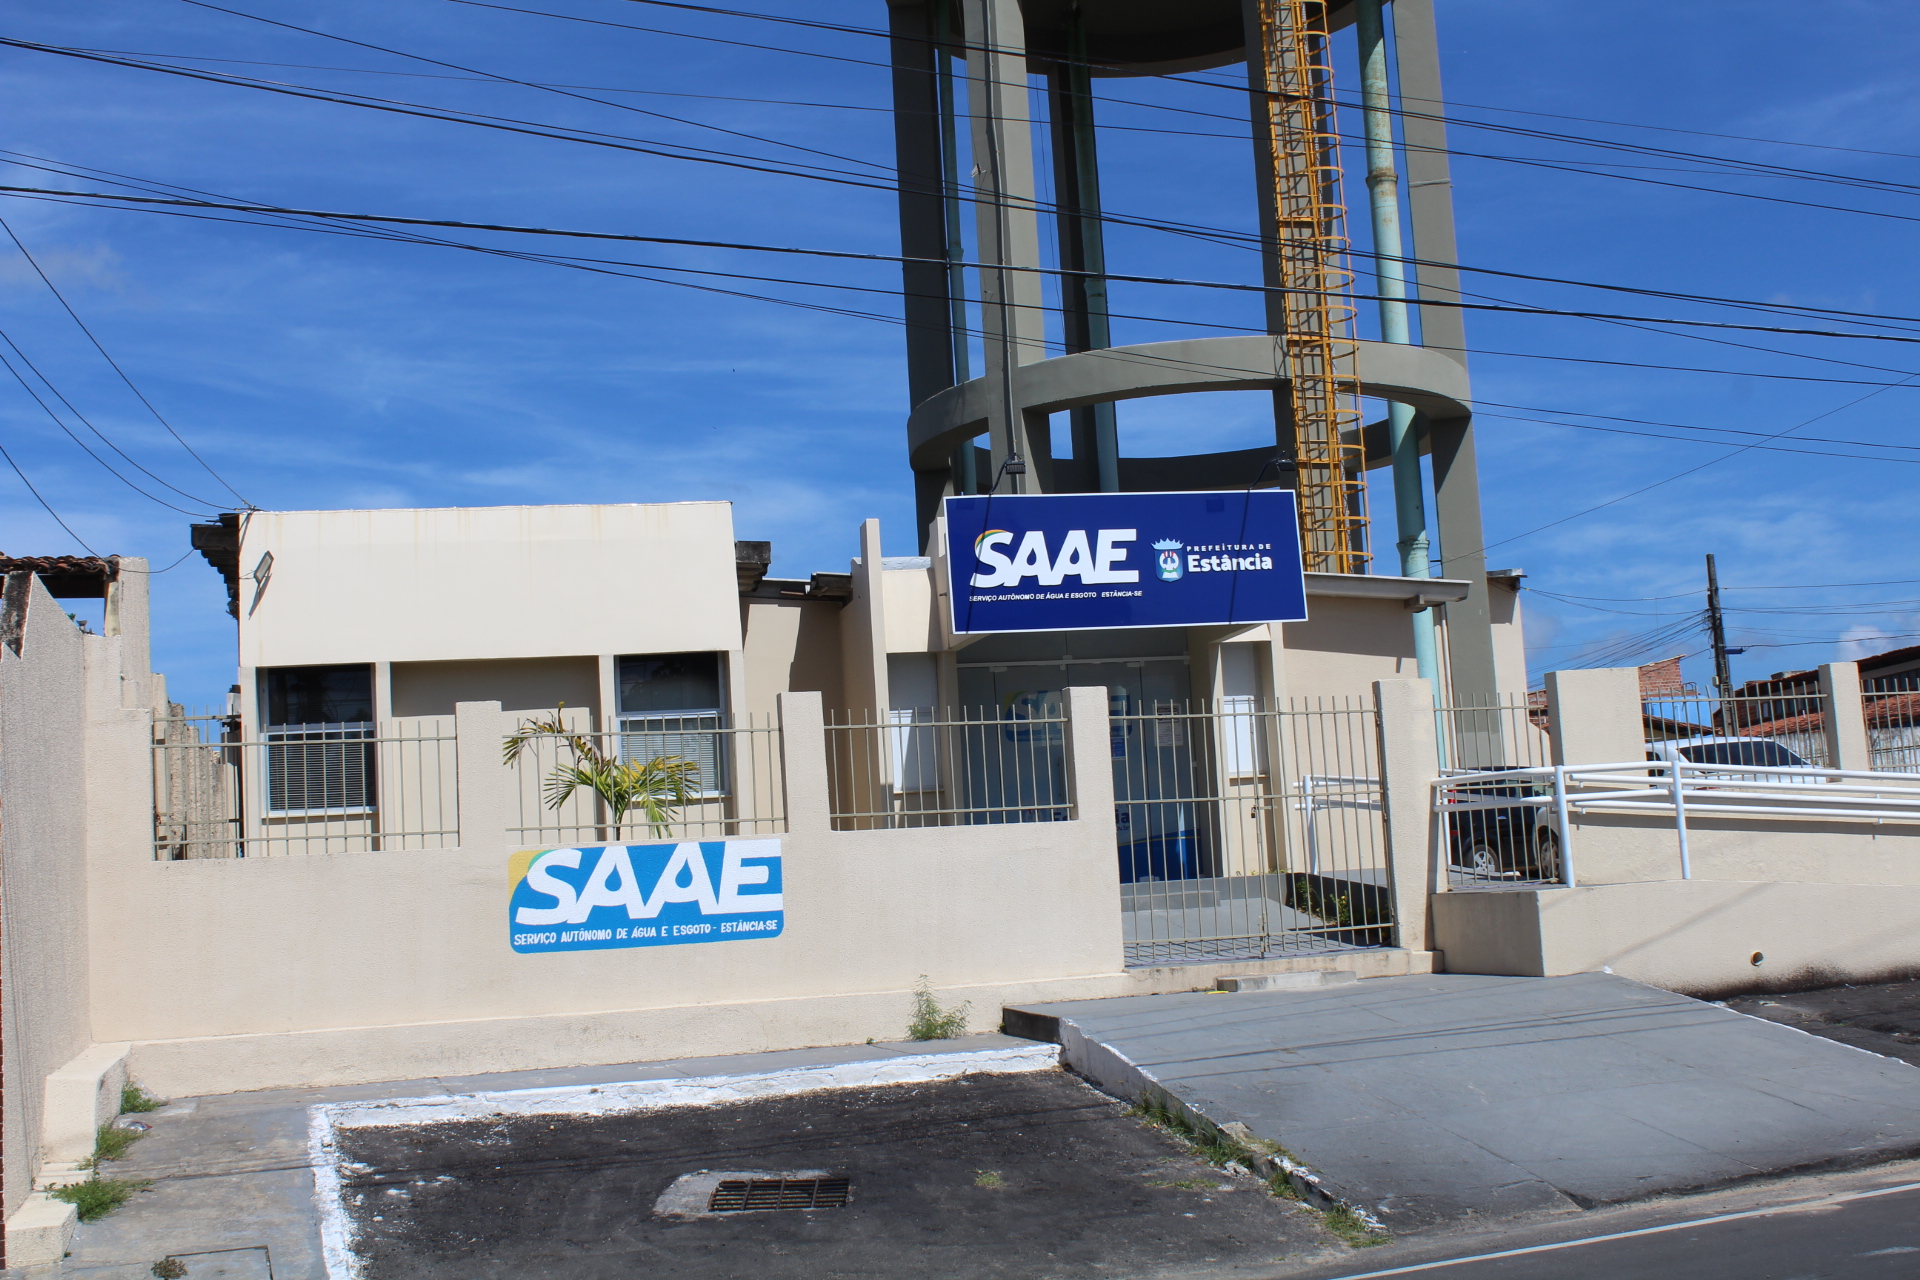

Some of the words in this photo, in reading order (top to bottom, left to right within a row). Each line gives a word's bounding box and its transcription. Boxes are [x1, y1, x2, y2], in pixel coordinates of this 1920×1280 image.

[969, 528, 1140, 588] SAAE
[1258, 542, 1272, 550] DE
[1187, 552, 1273, 573] Estância
[968, 595, 997, 603] SERVIÇO
[998, 592, 1034, 601] AUTÔNOMO
[1046, 591, 1064, 600] ÁGUA
[1070, 591, 1097, 599] ESGOTO
[515, 838, 784, 925] SAAE
[514, 932, 557, 946] SERVIÇO
[560, 927, 612, 943] AUTÔNOMO
[616, 928, 628, 939] DE
[631, 925, 657, 939] ÁGUA
[661, 925, 668, 937] E
[673, 923, 711, 936] ESGOTO
[720, 919, 778, 933] ESTÂNCIA-SE
